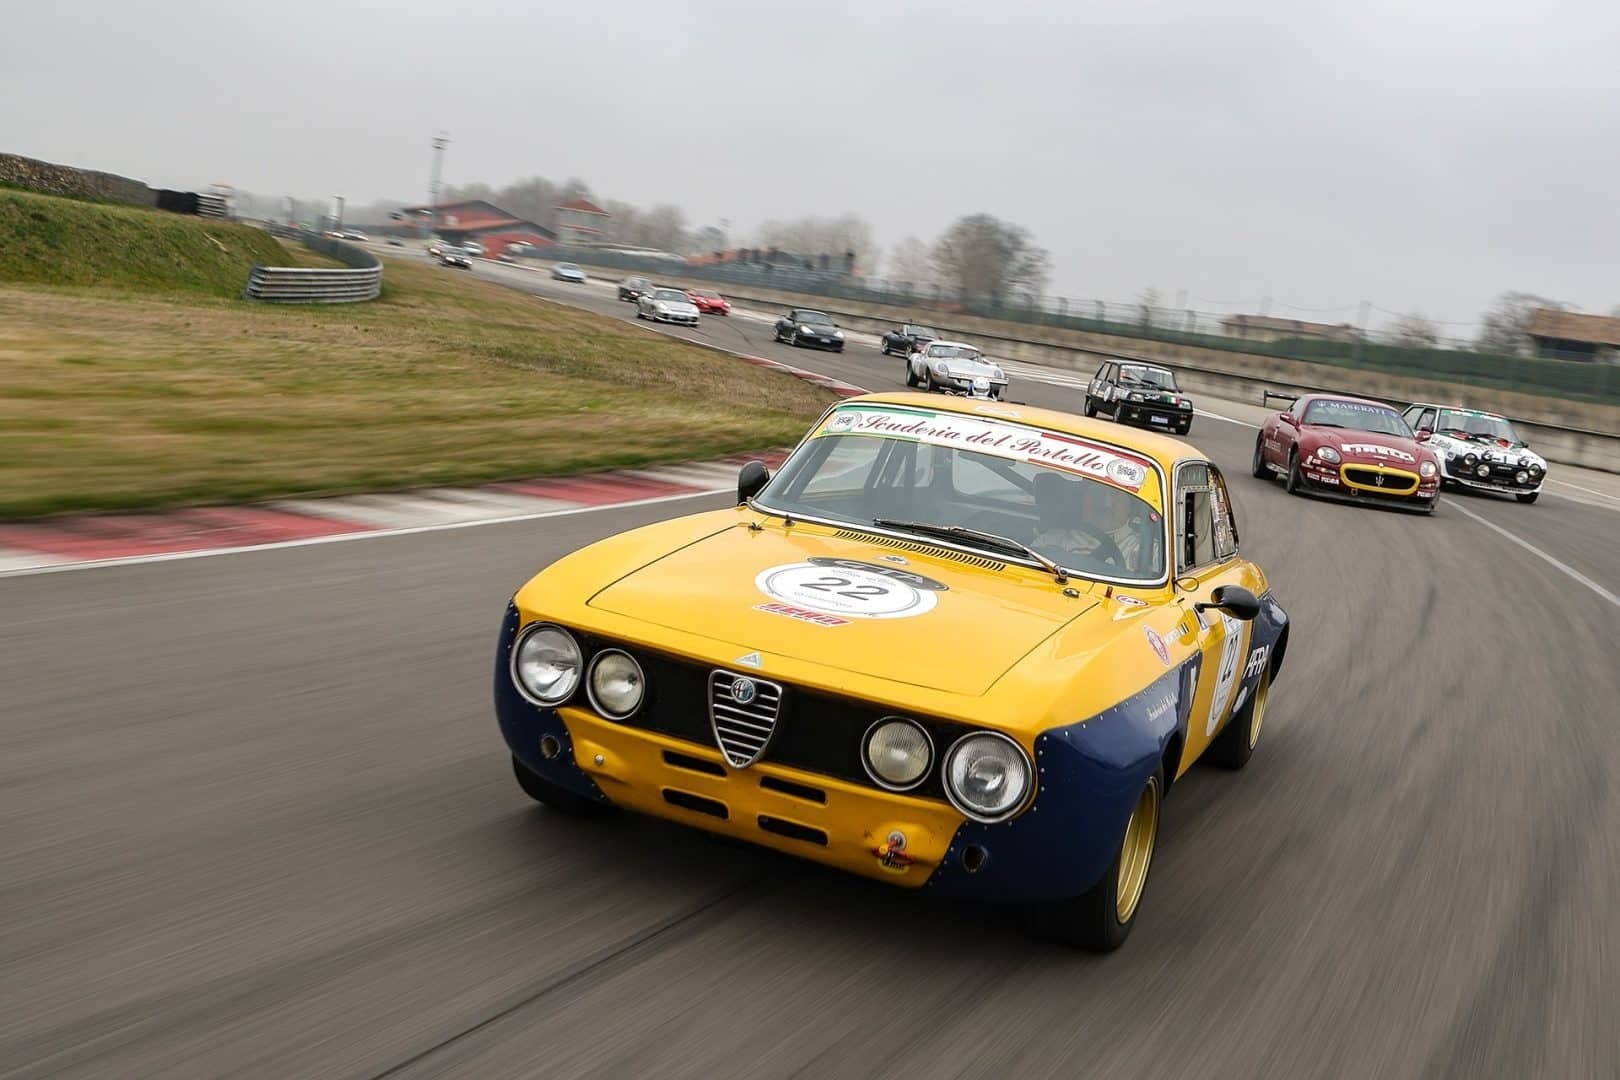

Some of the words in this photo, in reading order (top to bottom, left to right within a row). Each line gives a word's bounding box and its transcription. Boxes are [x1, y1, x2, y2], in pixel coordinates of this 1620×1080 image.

[1329, 402, 1386, 415] MASERATI
[858, 414, 961, 441] Scuderia
[966, 431, 1005, 447] del
[1010, 439, 1105, 471] Portello
[799, 576, 889, 601] 22
